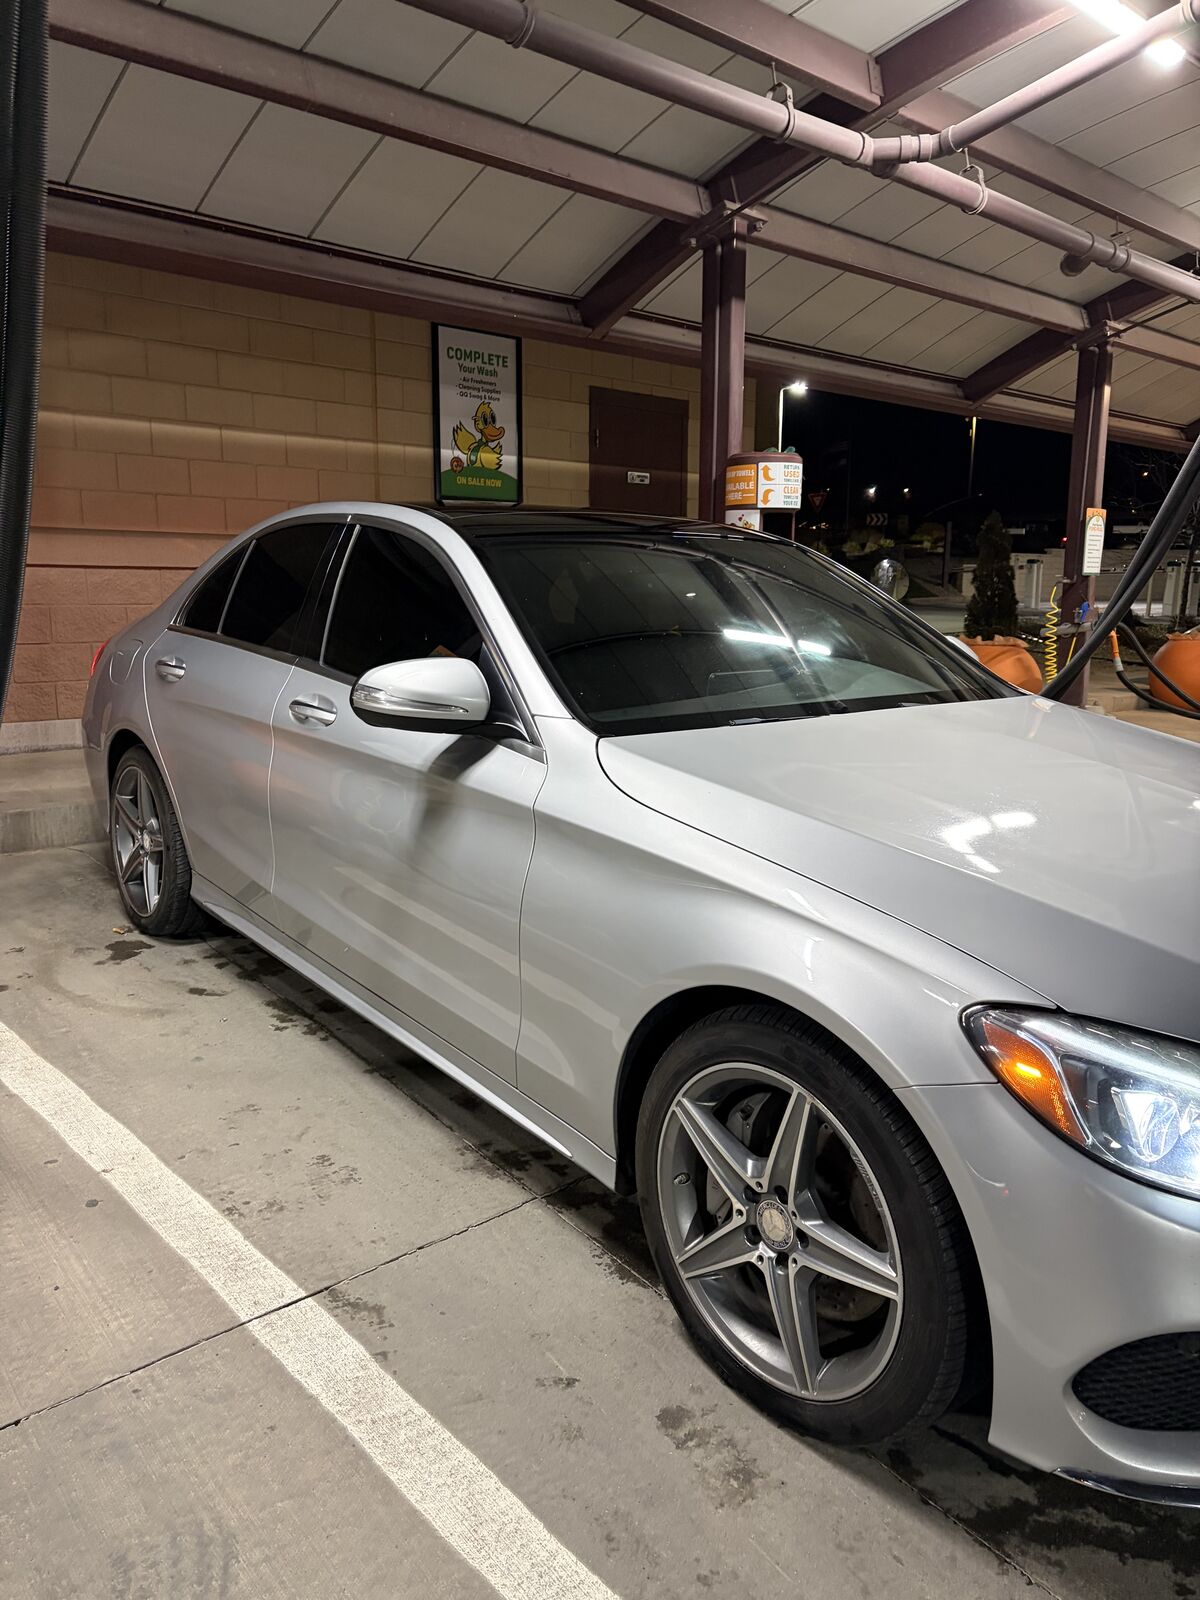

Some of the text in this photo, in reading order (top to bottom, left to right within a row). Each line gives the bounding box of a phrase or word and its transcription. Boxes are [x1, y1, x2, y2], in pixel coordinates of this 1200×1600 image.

[447, 347, 508, 368] COMPLETE
[458, 362, 498, 378] Your Wash
[471, 378, 496, 386] Fresheners
[459, 384, 501, 395] Cleaning Supplies
[784, 470, 800, 478] USED
[457, 476, 502, 488] ON SALE NOW
